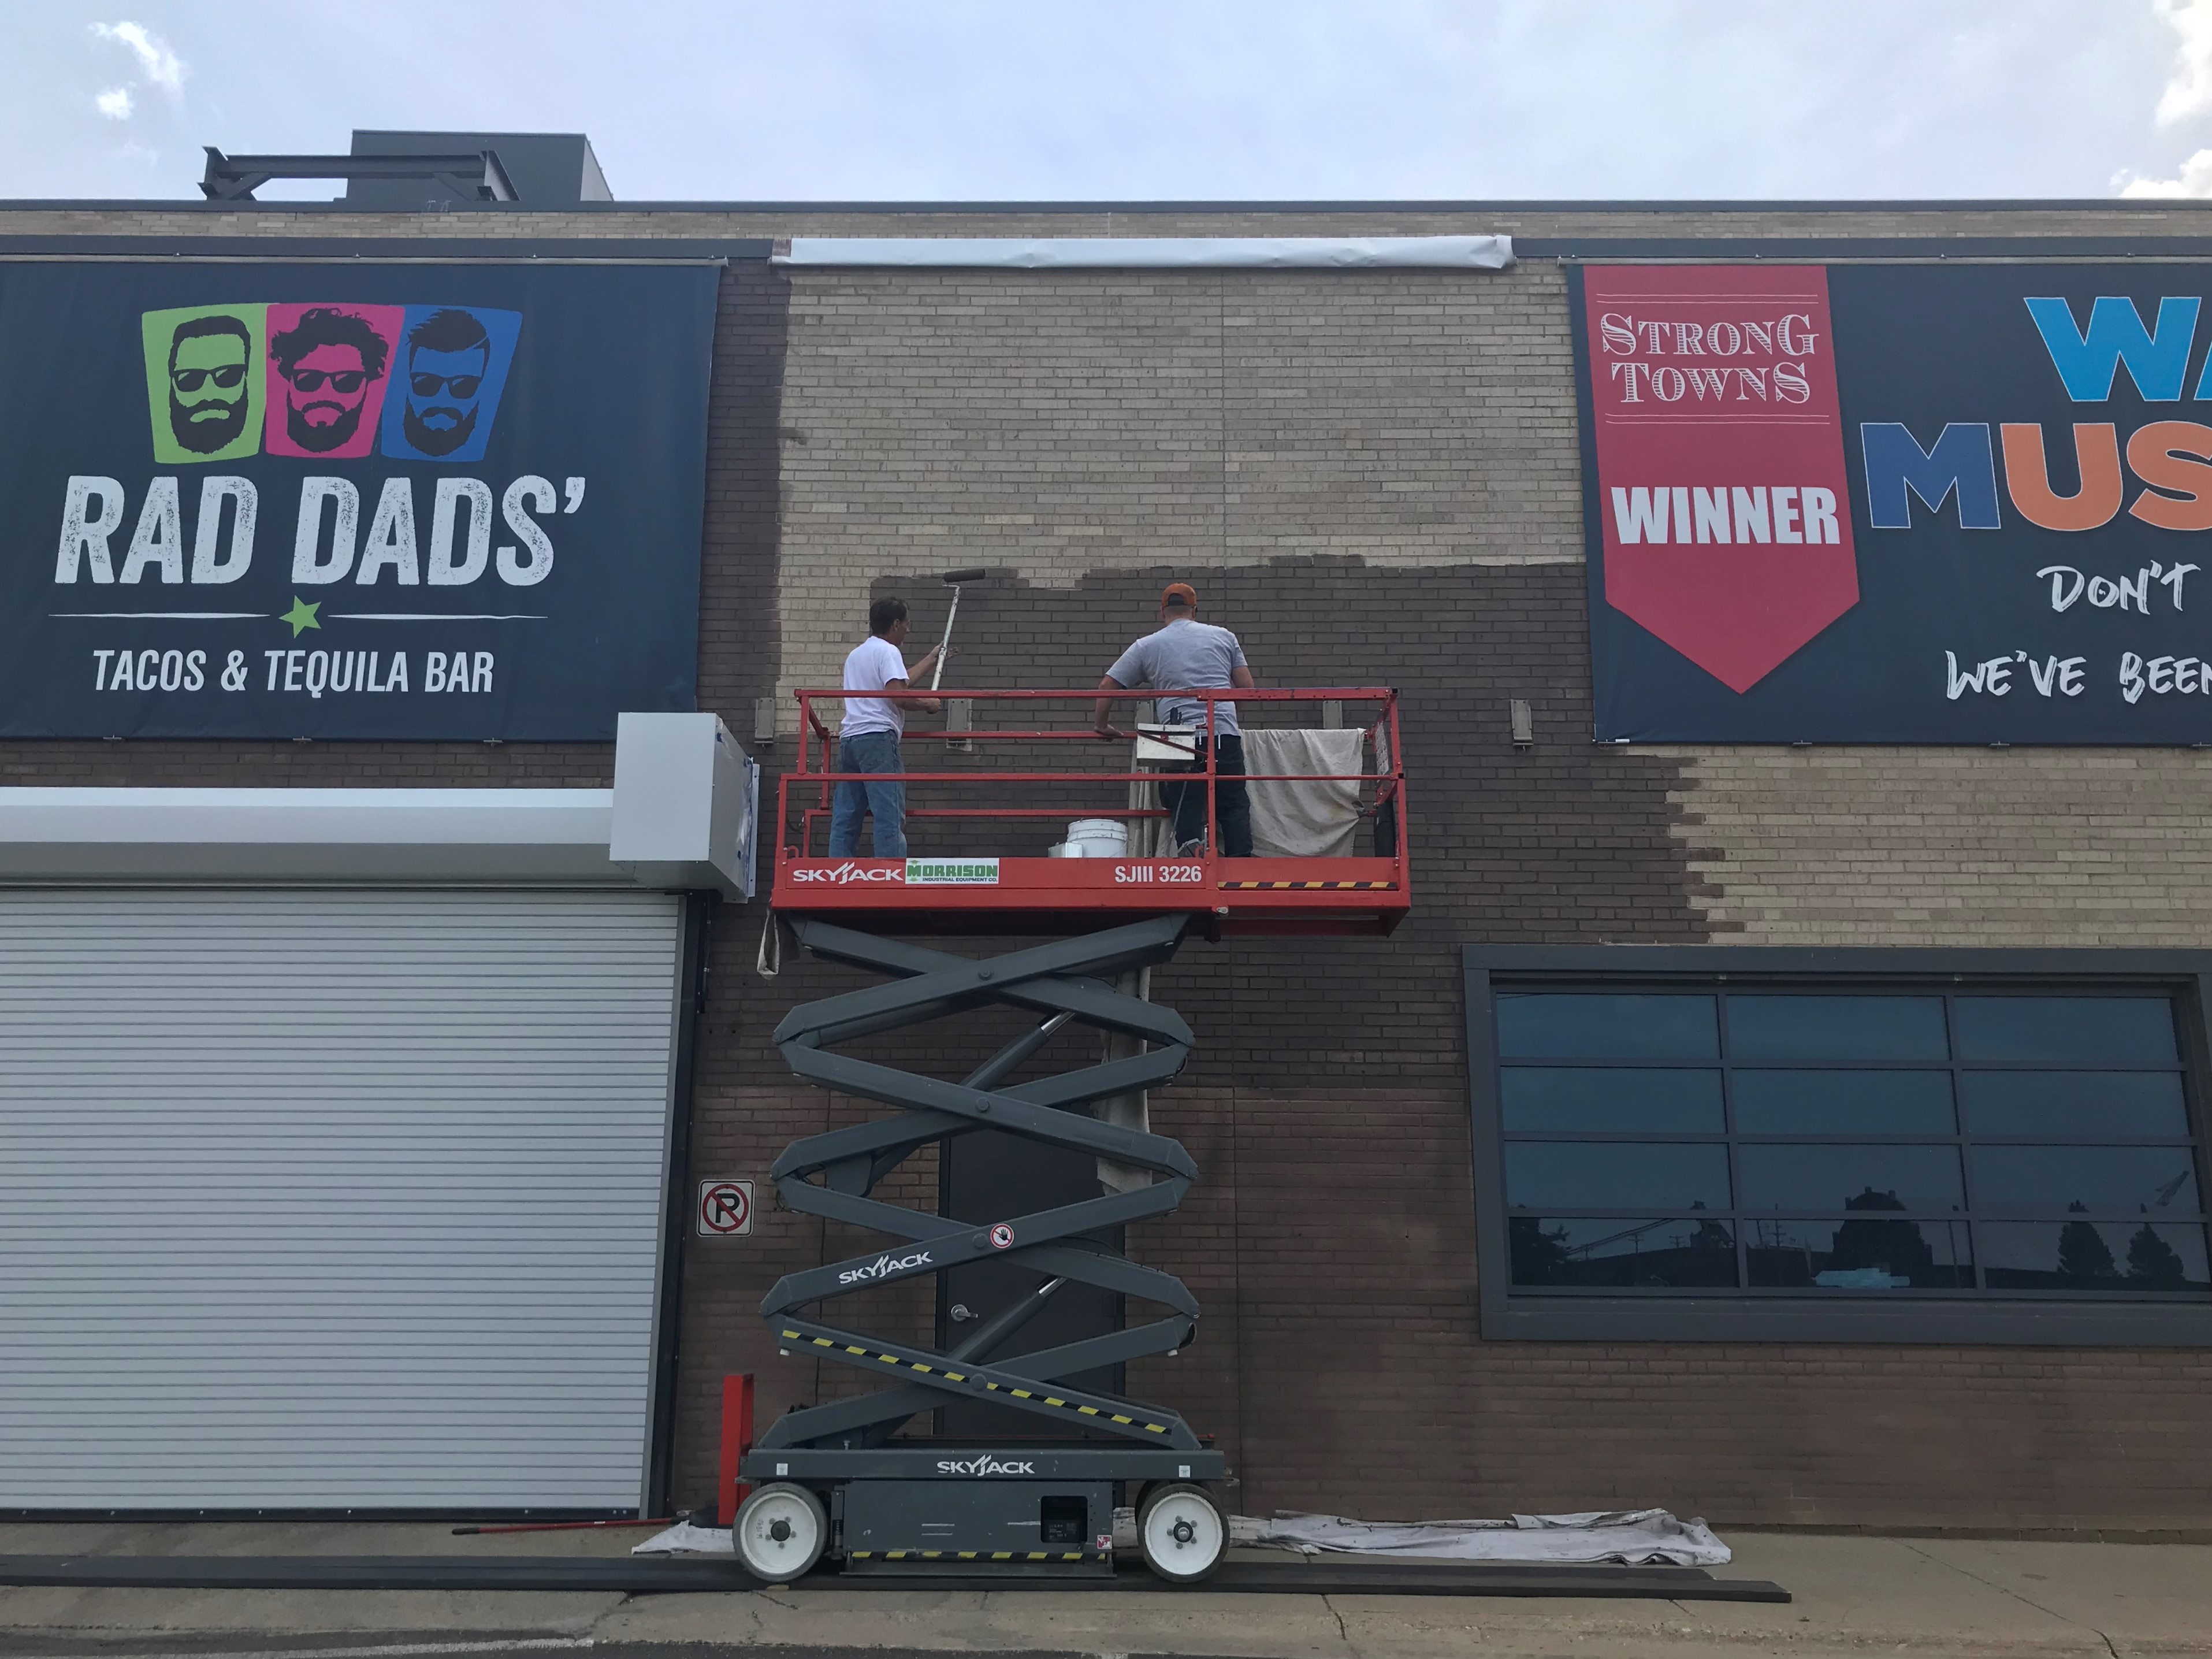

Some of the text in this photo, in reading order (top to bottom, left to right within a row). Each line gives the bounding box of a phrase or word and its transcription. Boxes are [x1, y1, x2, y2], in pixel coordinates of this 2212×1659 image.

[1601, 313, 1819, 356] STRONG
[2023, 296, 2212, 402] W
[1612, 362, 1810, 404] TOWNS
[1860, 421, 2212, 531] MUS
[55, 475, 585, 586] RAD DADS'
[1611, 487, 1841, 544] WINNER
[2036, 560, 2200, 614] DON'T
[93, 650, 494, 699] TACOS & TEQUILA BAR
[1946, 650, 2087, 700] WE'VE
[793, 862, 904, 885] SKYJACK
[907, 864, 998, 877] MORRISON
[1115, 866, 1202, 882] SJIII 3226
[838, 1251, 934, 1284] SKYJACK
[936, 1454, 1035, 1476] SKYJACK
